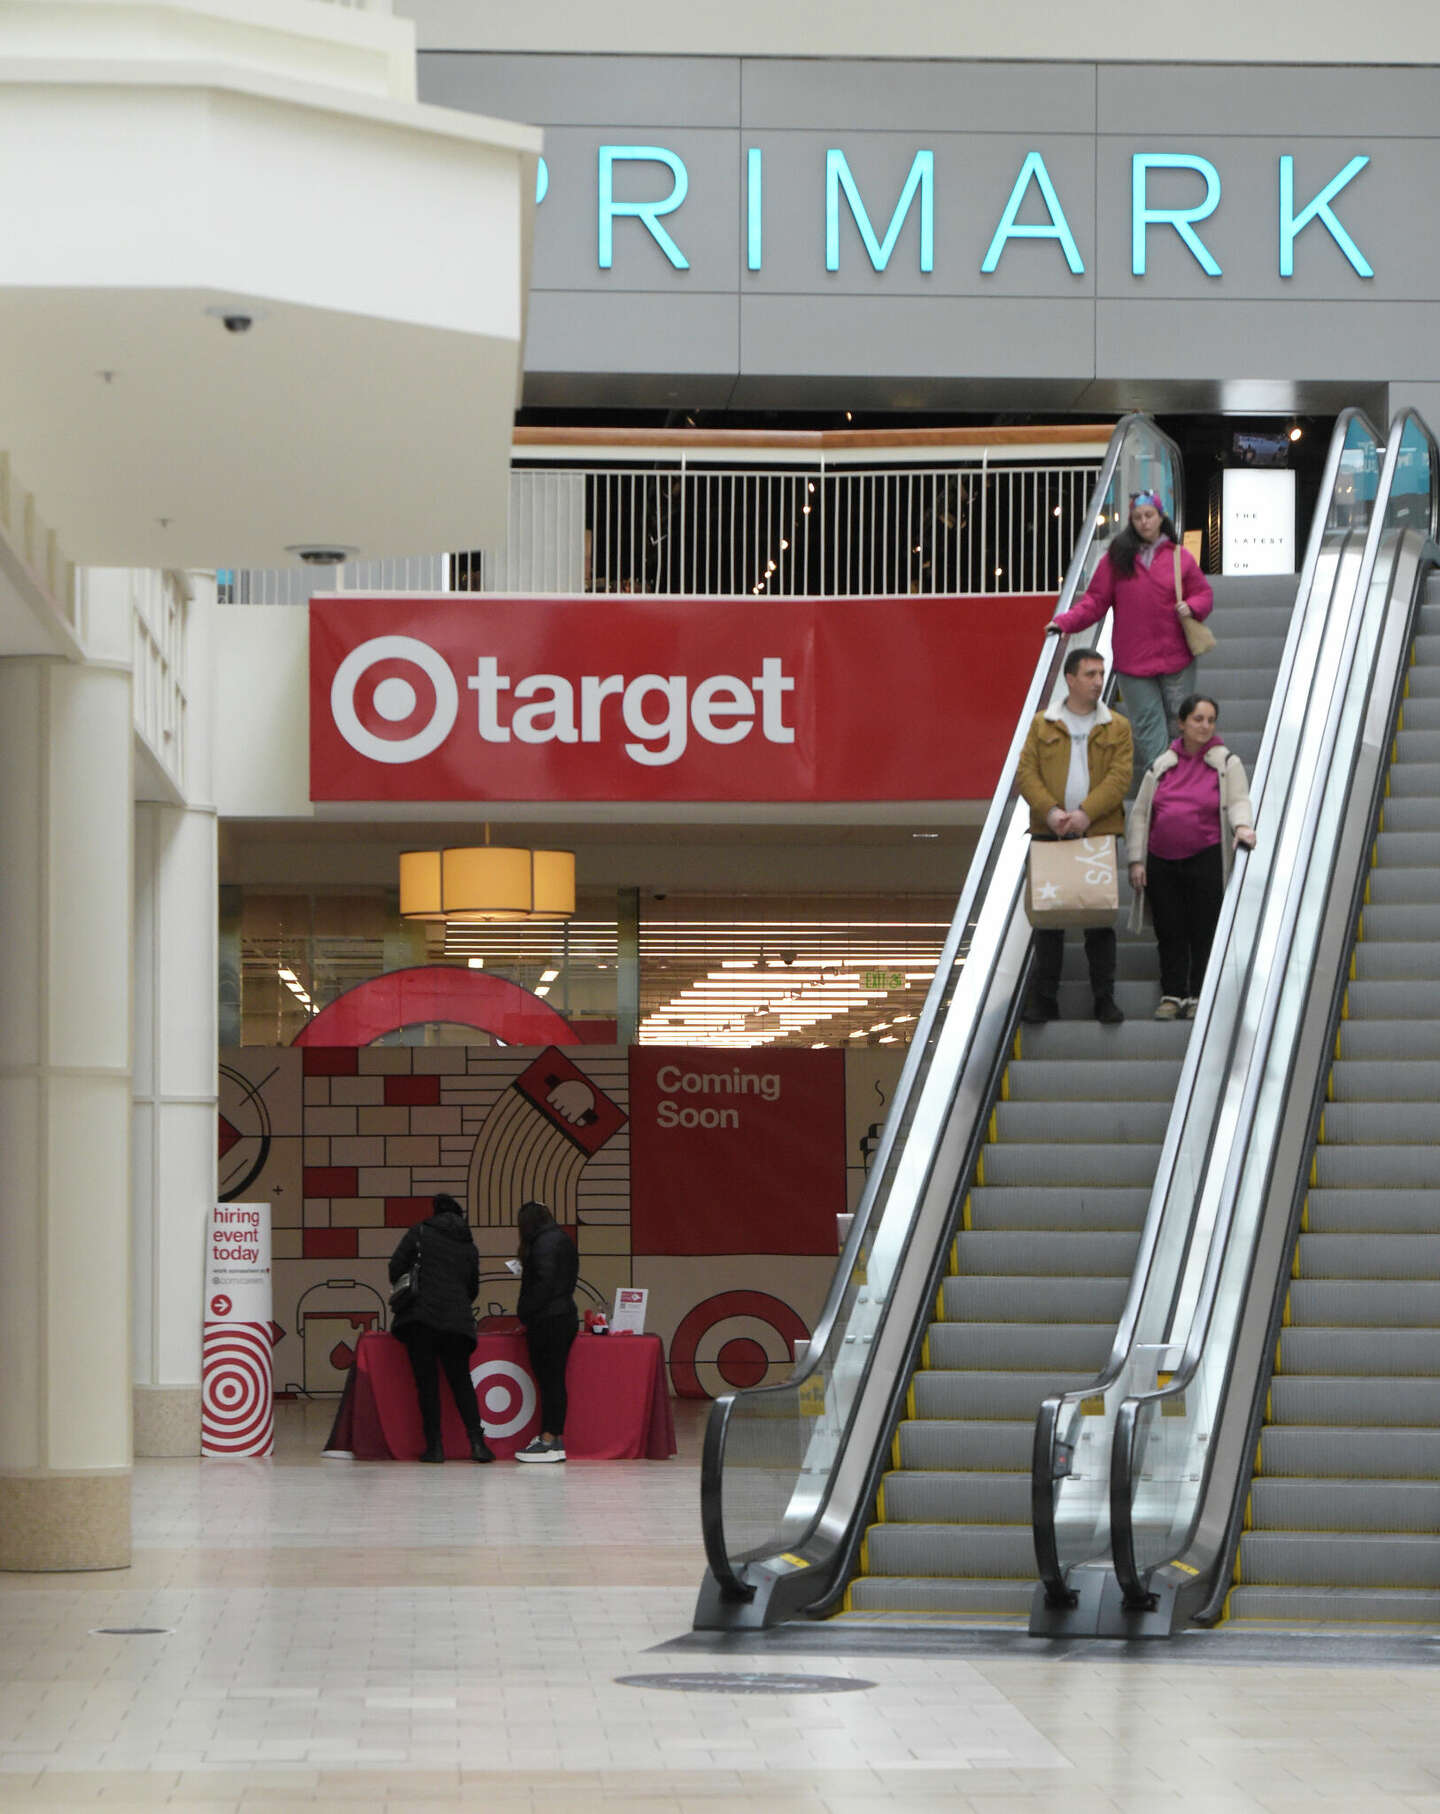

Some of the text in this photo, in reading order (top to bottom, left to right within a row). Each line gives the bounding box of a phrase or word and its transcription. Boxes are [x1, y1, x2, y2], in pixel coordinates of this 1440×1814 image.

[536, 144, 1375, 278] RIMARK
[1234, 537, 1283, 545] LATEST
[468, 656, 795, 766] target
[865, 972, 886, 988] EXIT
[656, 1066, 781, 1101] Coming
[656, 1101, 739, 1129] Soon
[213, 1208, 260, 1226] hiring
[213, 1228, 259, 1243] event
[213, 1245, 259, 1263] today
